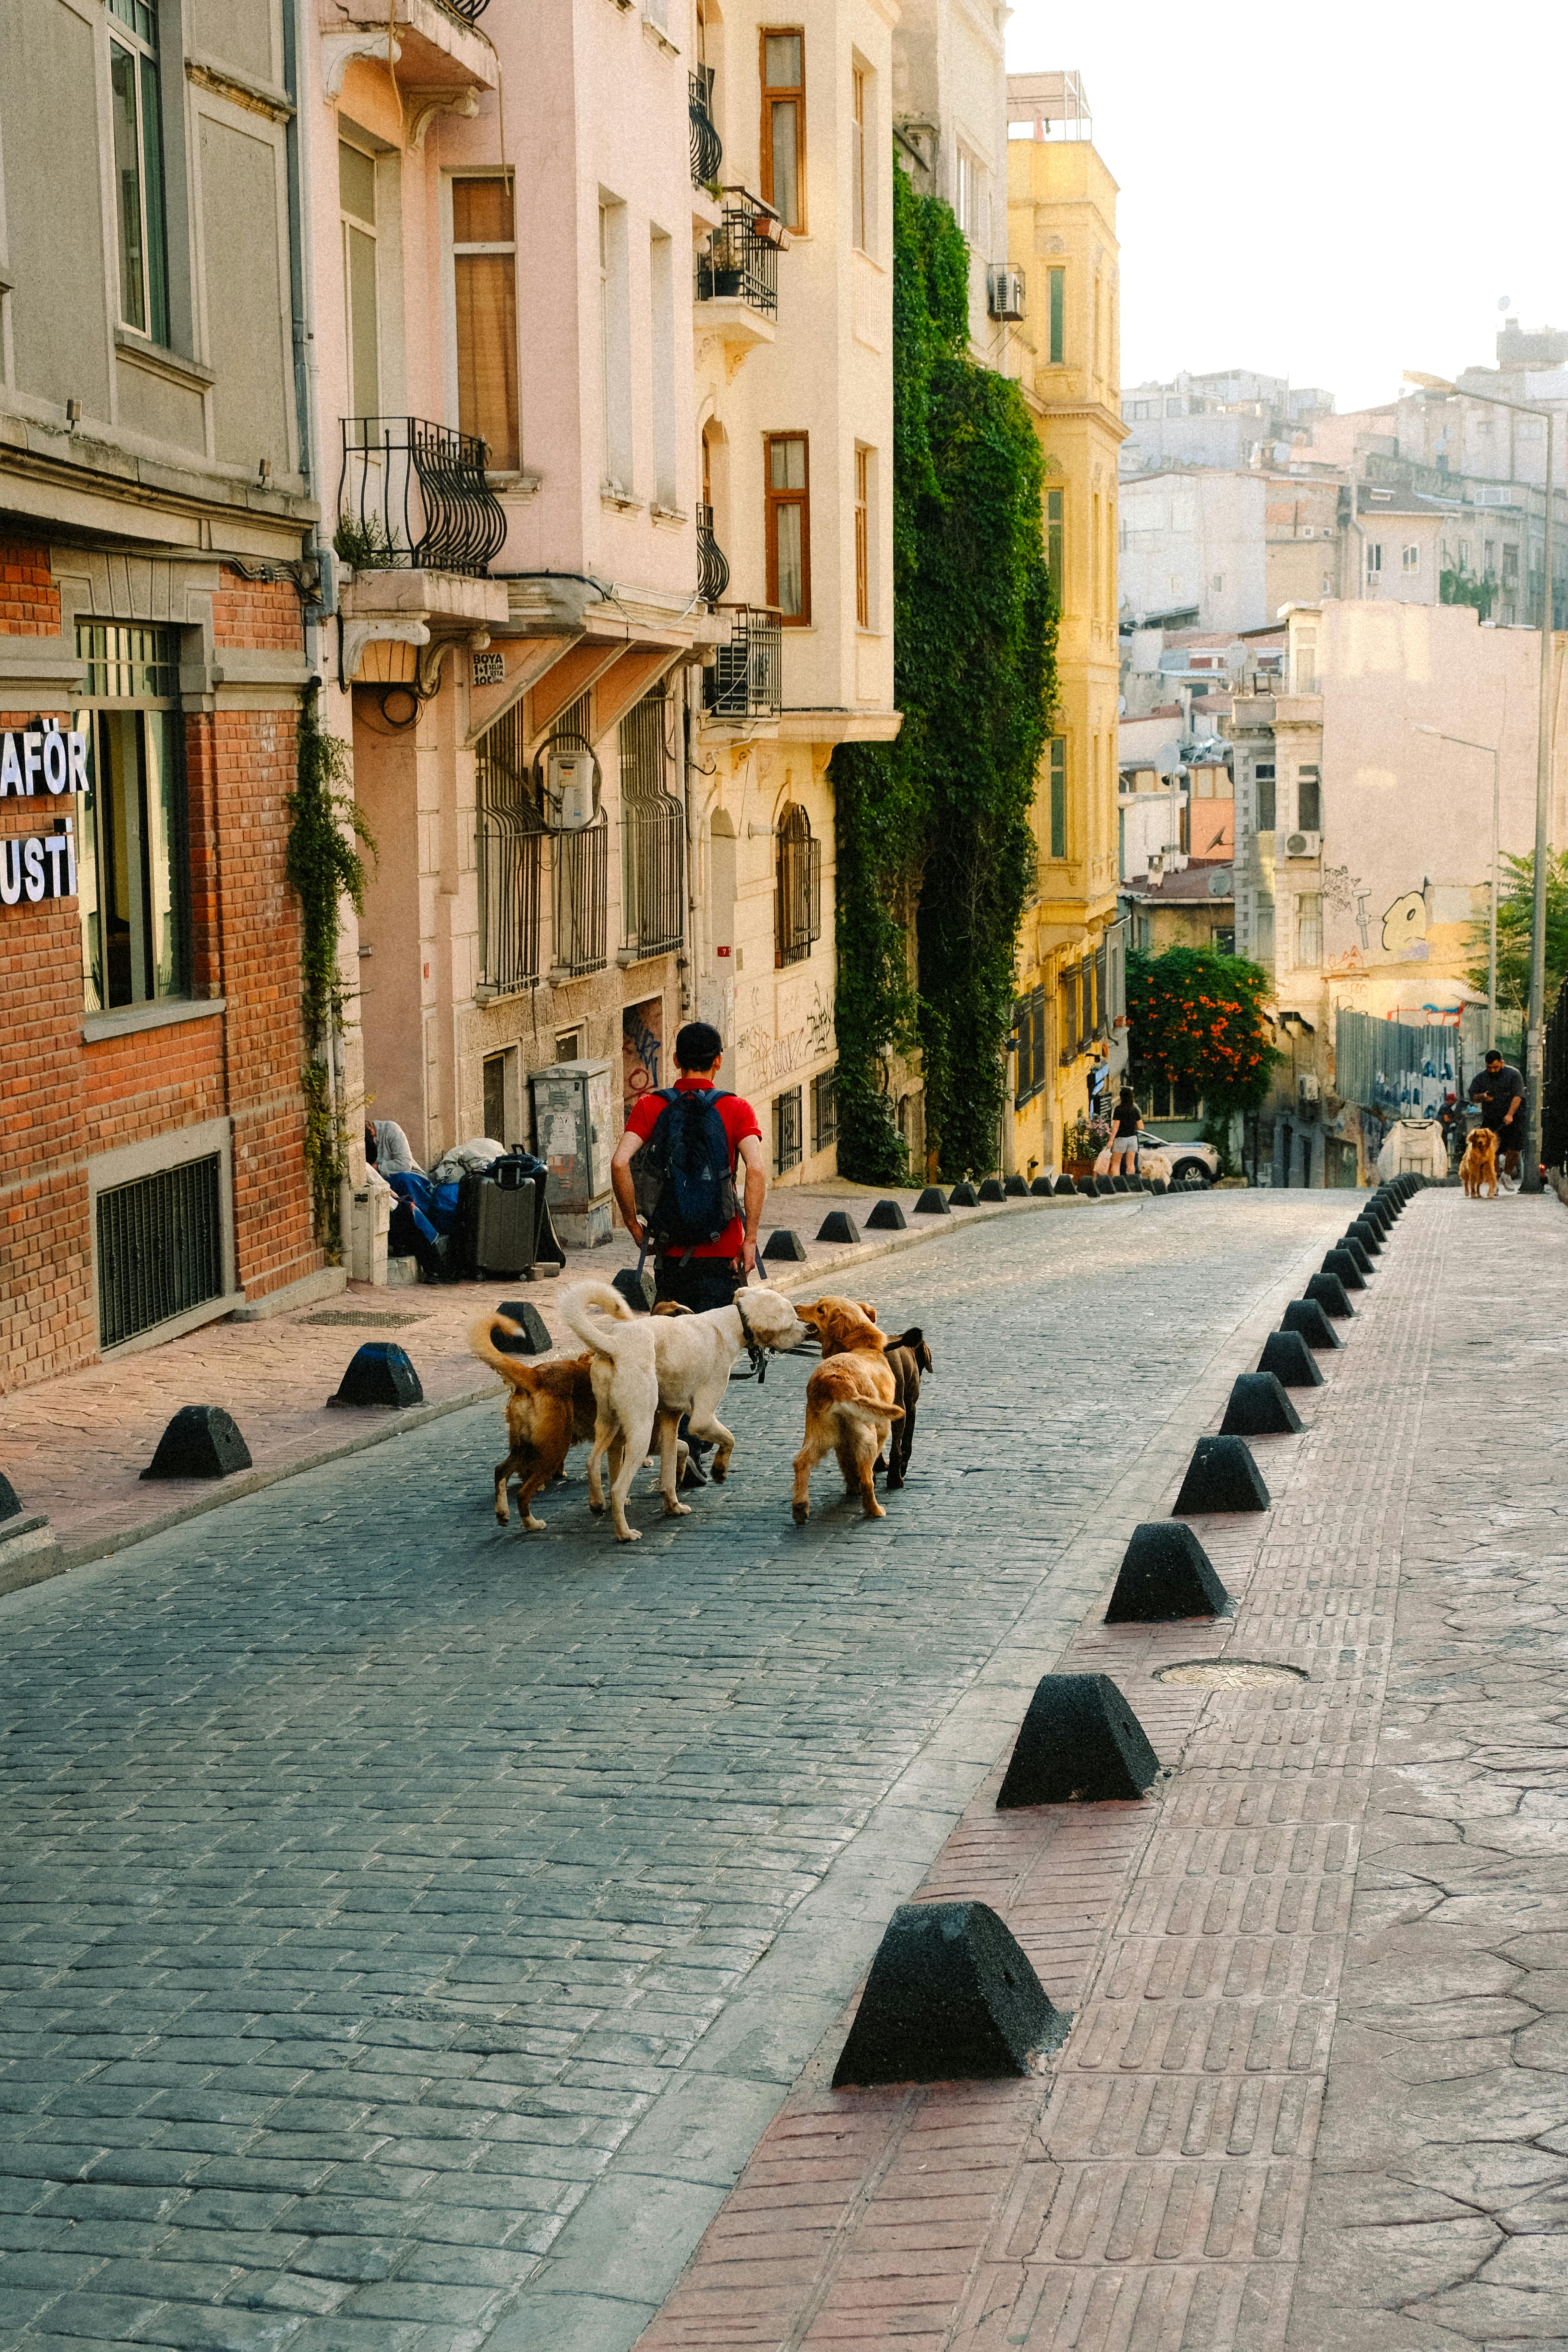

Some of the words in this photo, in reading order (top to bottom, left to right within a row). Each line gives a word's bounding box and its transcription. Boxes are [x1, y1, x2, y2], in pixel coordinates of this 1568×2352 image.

[474, 654, 503, 664] BOYA
[474, 664, 488, 675] 1+1
[0, 718, 90, 796] AFÖR
[0, 817, 76, 904] USTİ
